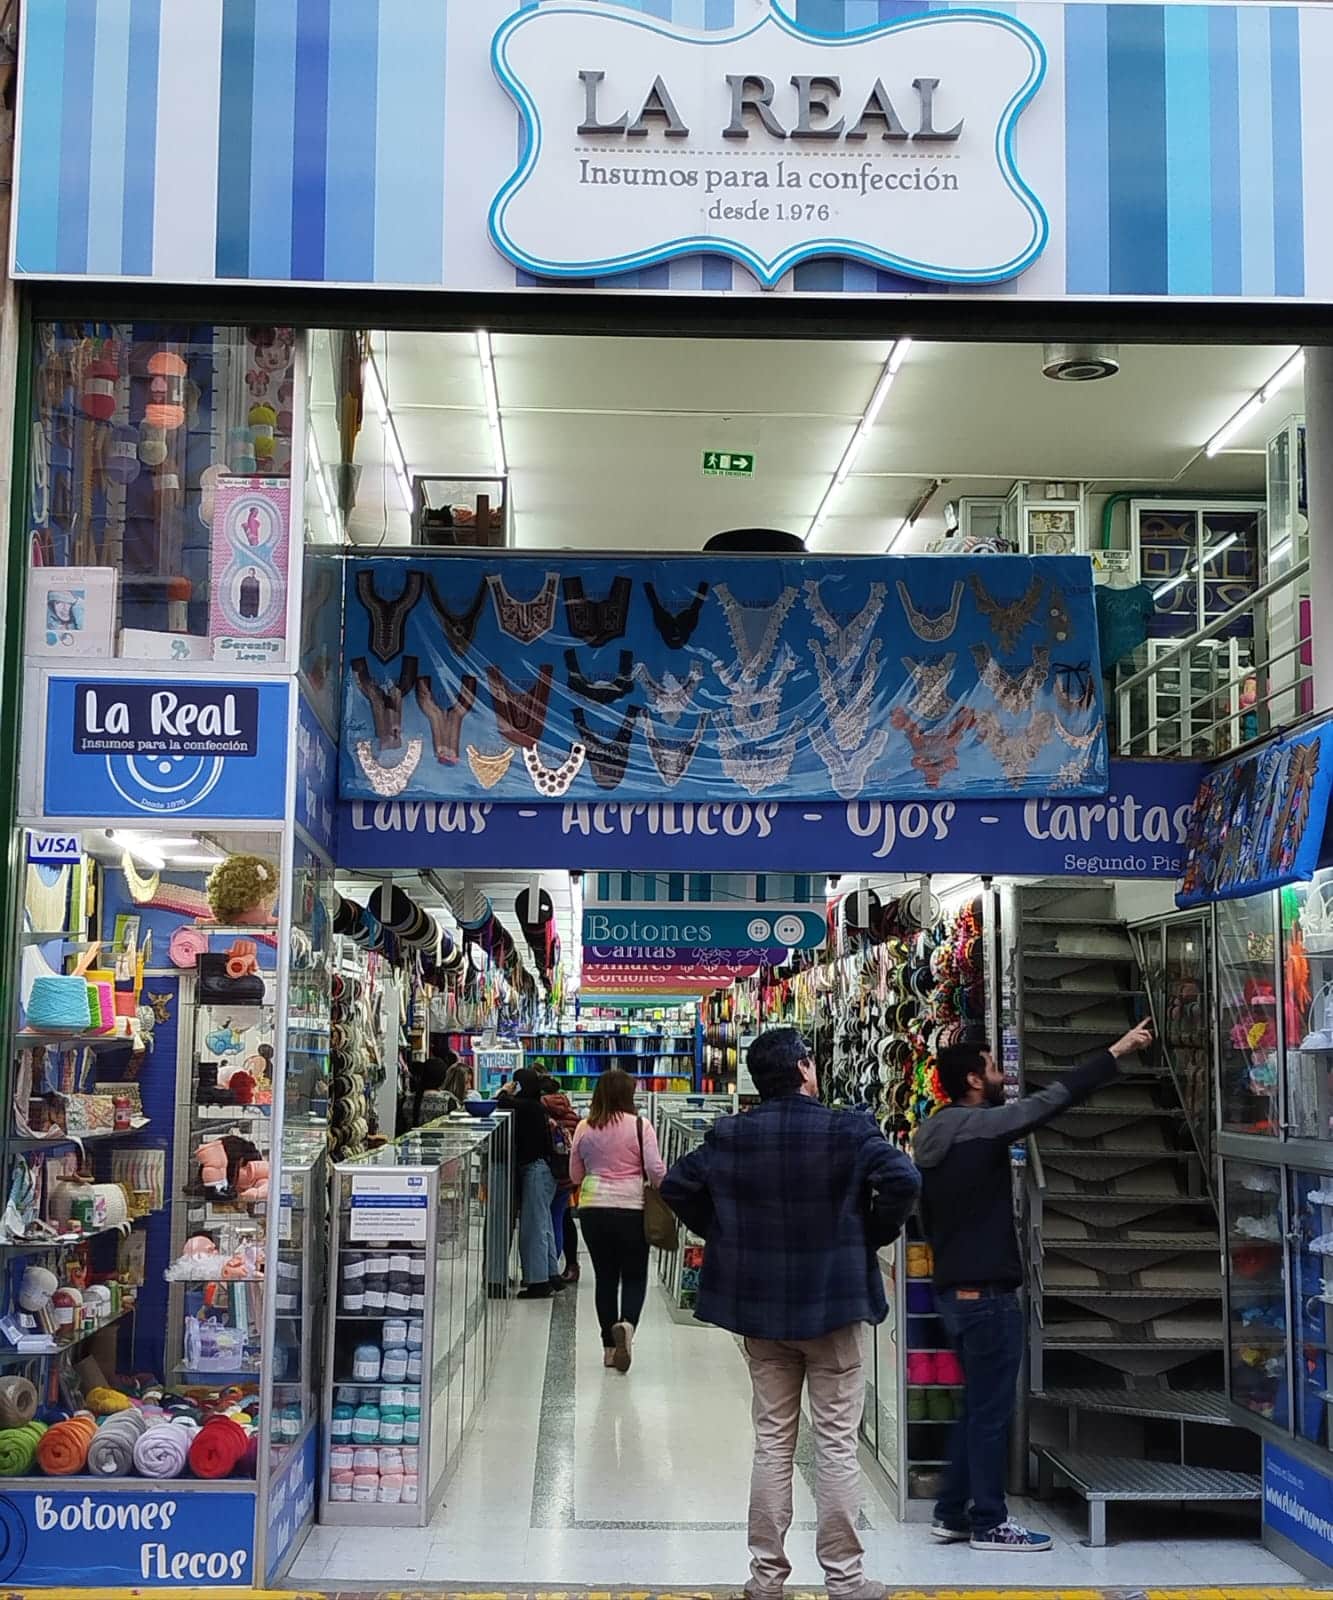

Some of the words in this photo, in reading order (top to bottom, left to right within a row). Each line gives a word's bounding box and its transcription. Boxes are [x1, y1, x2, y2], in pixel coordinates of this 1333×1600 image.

[576, 70, 691, 138] LA
[721, 74, 966, 142] REAL
[579, 159, 698, 187] Insumos
[705, 166, 770, 193] para
[776, 161, 804, 188] la
[808, 164, 959, 196] confección
[708, 200, 770, 221] desde
[775, 203, 830, 222] 1.976
[86, 689, 130, 734] La
[151, 690, 242, 736] Real
[81, 737, 135, 750] Insumos
[137, 740, 167, 752] para
[169, 738, 181, 750] la
[183, 738, 249, 752] confección
[351, 801, 492, 834] Lanas
[846, 801, 956, 858] Ojos
[1023, 795, 1192, 843] Caritas
[36, 837, 78, 853] VISA
[1064, 854, 1146, 873] Segundo
[587, 914, 712, 942] Botones
[591, 945, 677, 959] Caritas
[35, 1495, 177, 1531] Botones
[140, 1543, 248, 1580] Flecos
